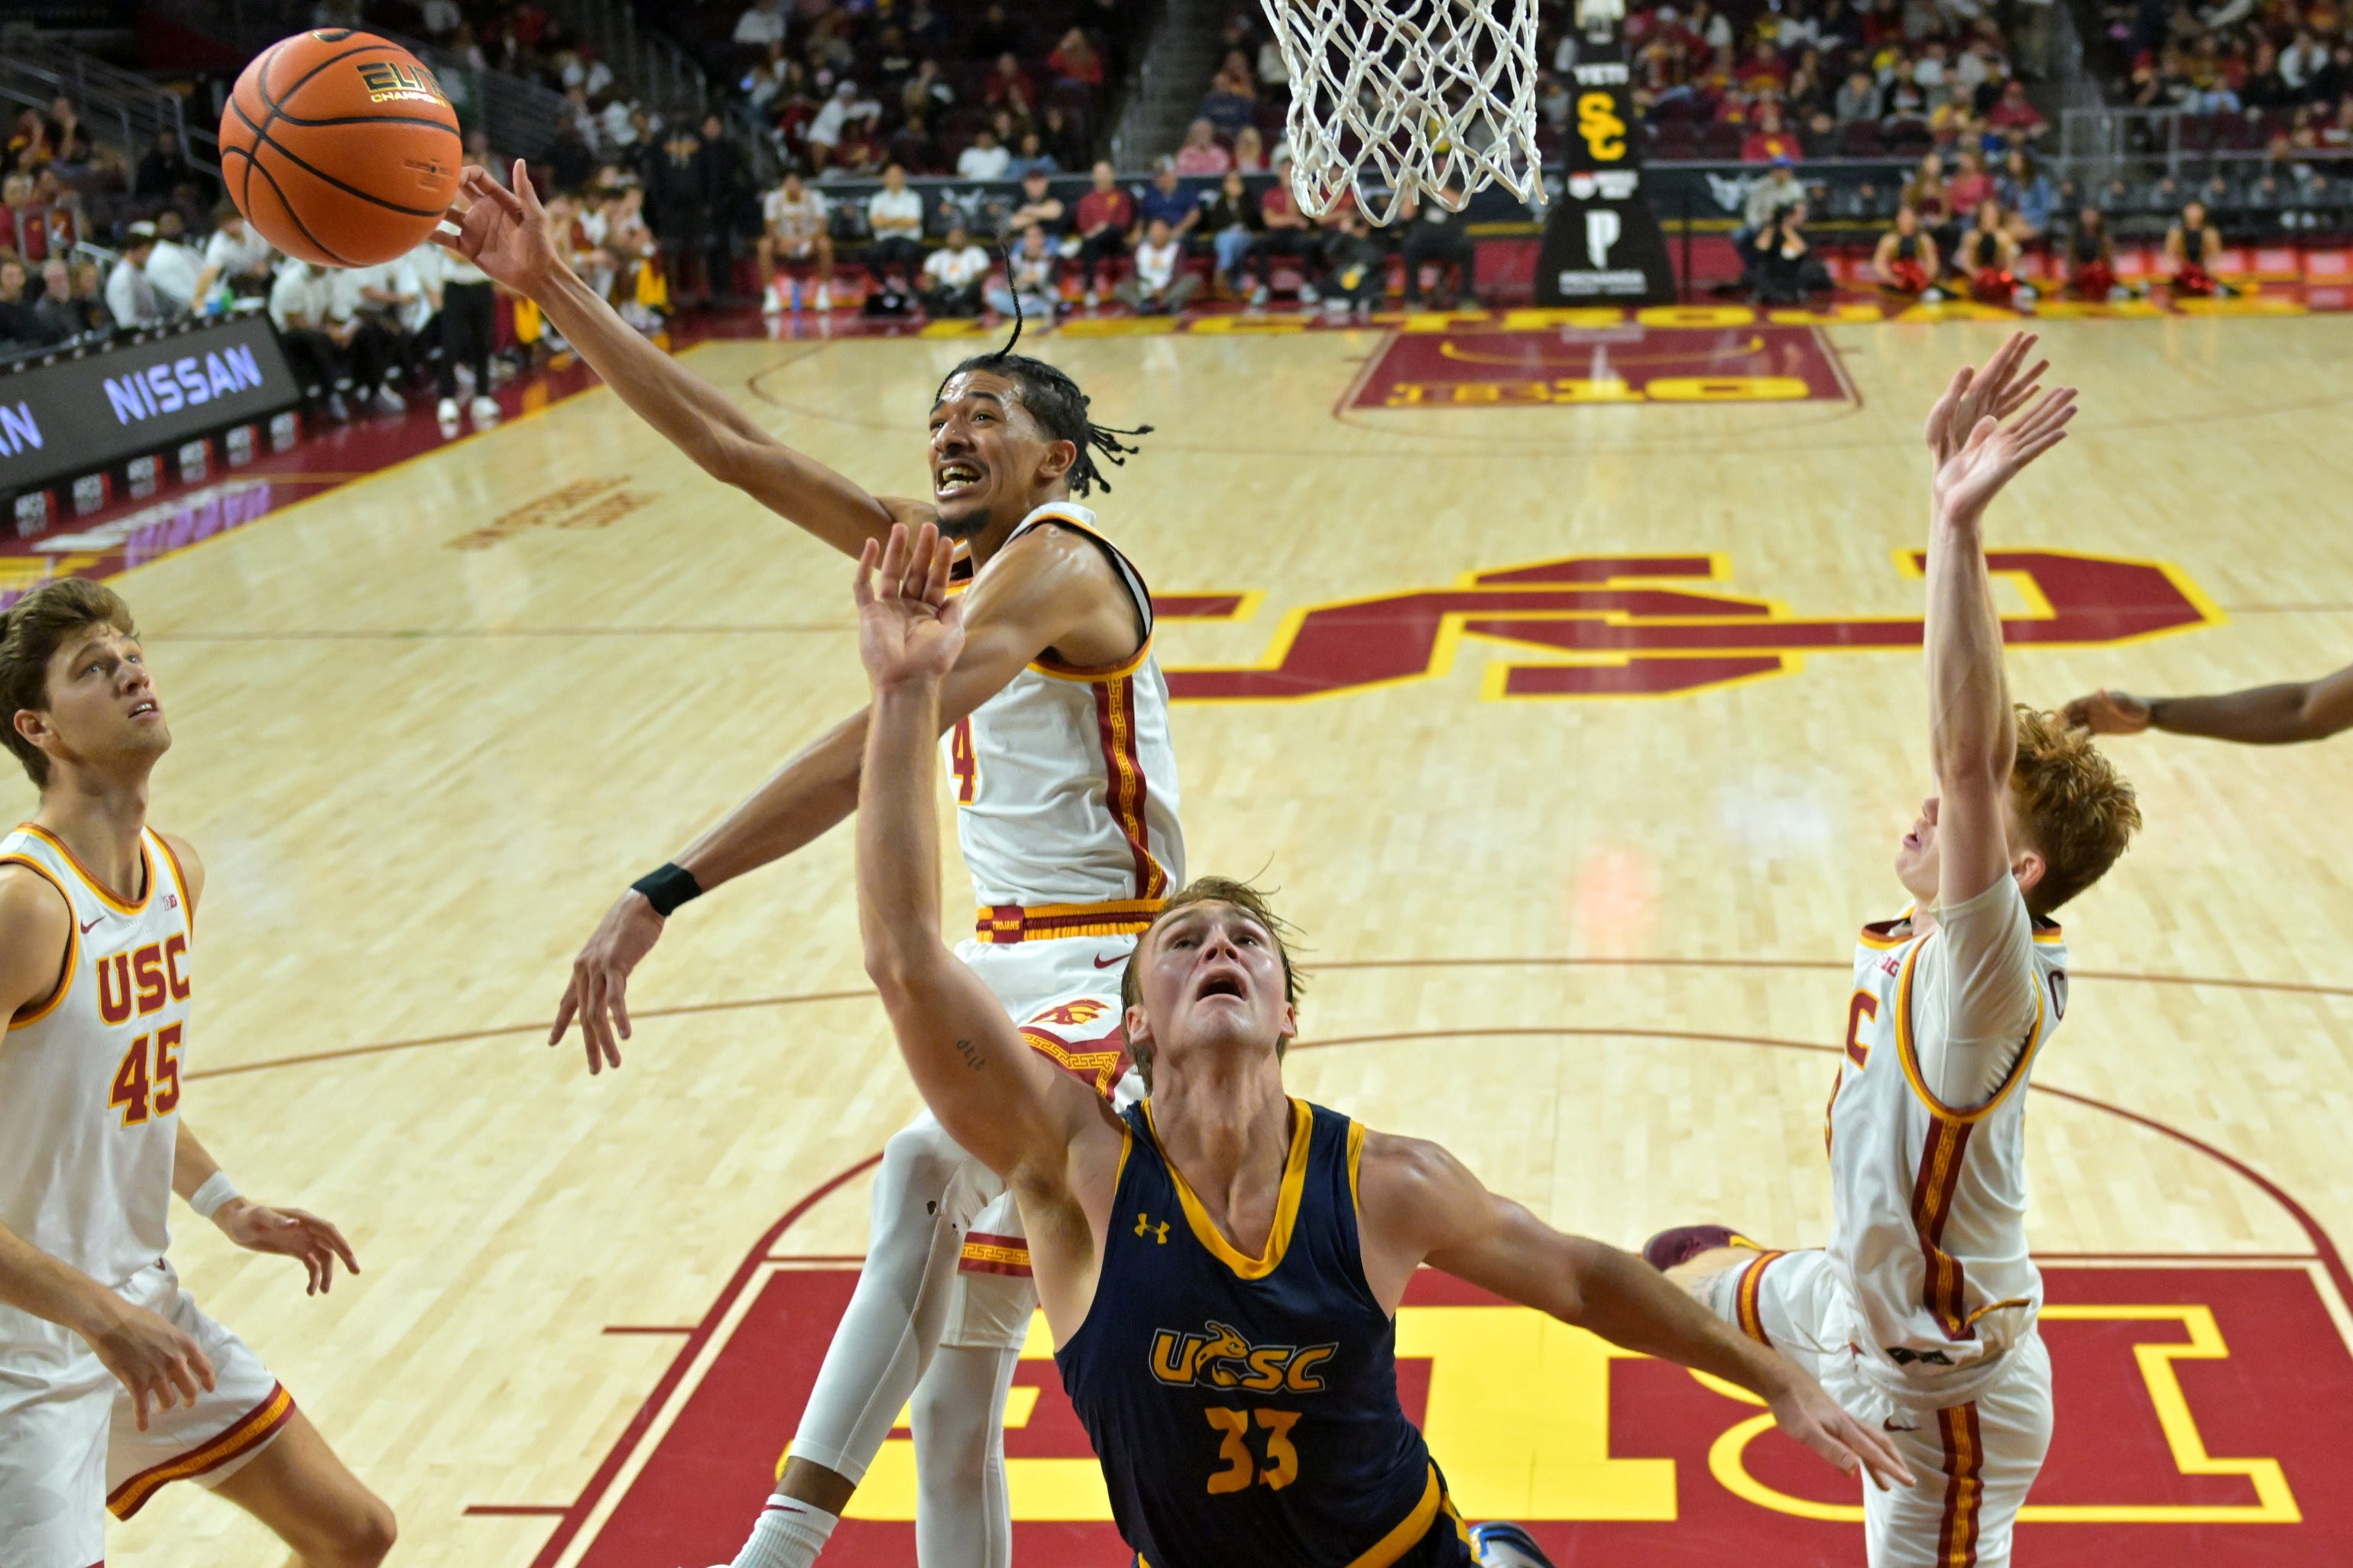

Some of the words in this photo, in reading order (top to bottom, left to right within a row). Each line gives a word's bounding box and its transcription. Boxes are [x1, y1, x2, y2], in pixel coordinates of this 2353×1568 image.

[102, 343, 263, 425] NISSAN
[992, 920, 1020, 931] TROJANS
[96, 931, 190, 1026] USC
[108, 1019, 183, 1127] 45
[1205, 1407, 1302, 1495] 33
